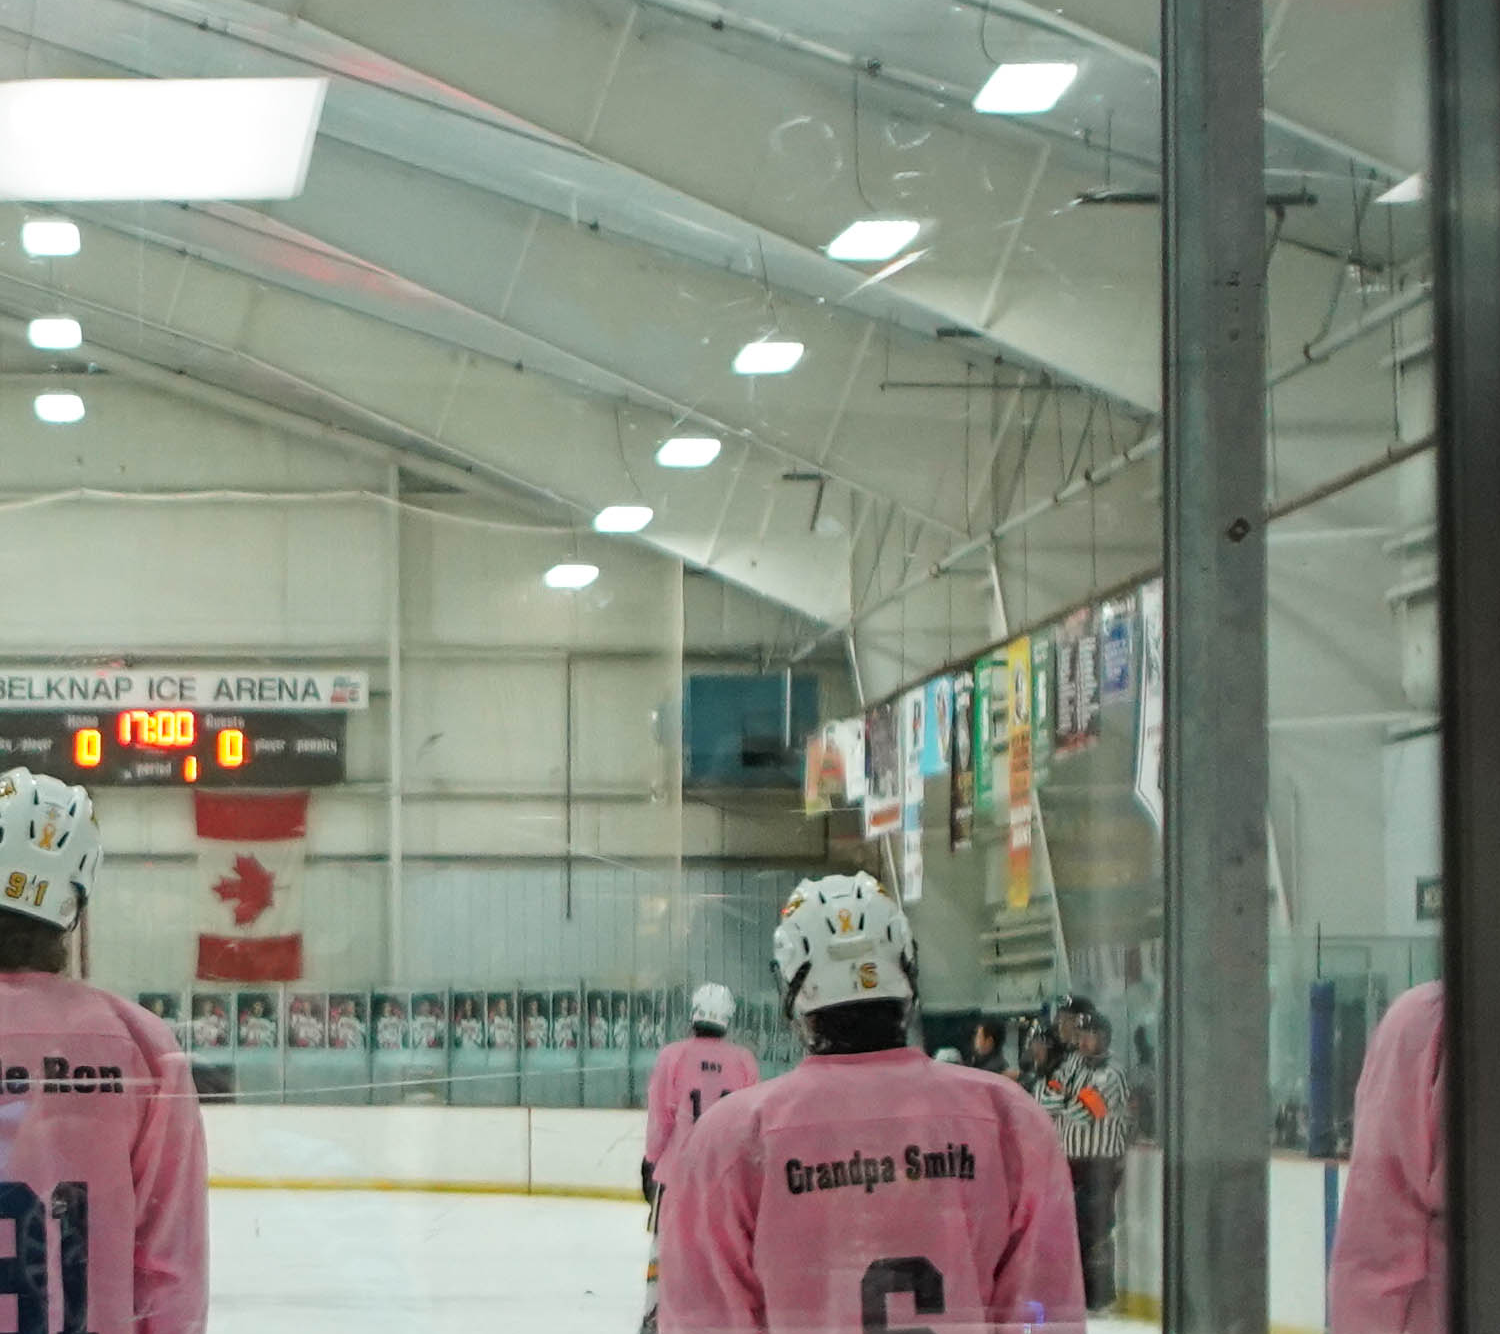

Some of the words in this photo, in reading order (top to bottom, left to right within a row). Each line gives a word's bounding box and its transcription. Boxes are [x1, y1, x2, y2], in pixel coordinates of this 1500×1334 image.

[149, 676, 197, 701] ICE
[214, 676, 321, 701] ARENA
[74, 728, 102, 768] 0
[117, 709, 197, 748] 17:00
[217, 728, 245, 768] 0
[5, 871, 49, 907] 91
[42, 1056, 125, 1095] Ron
[785, 1149, 897, 1195] Grandpa
